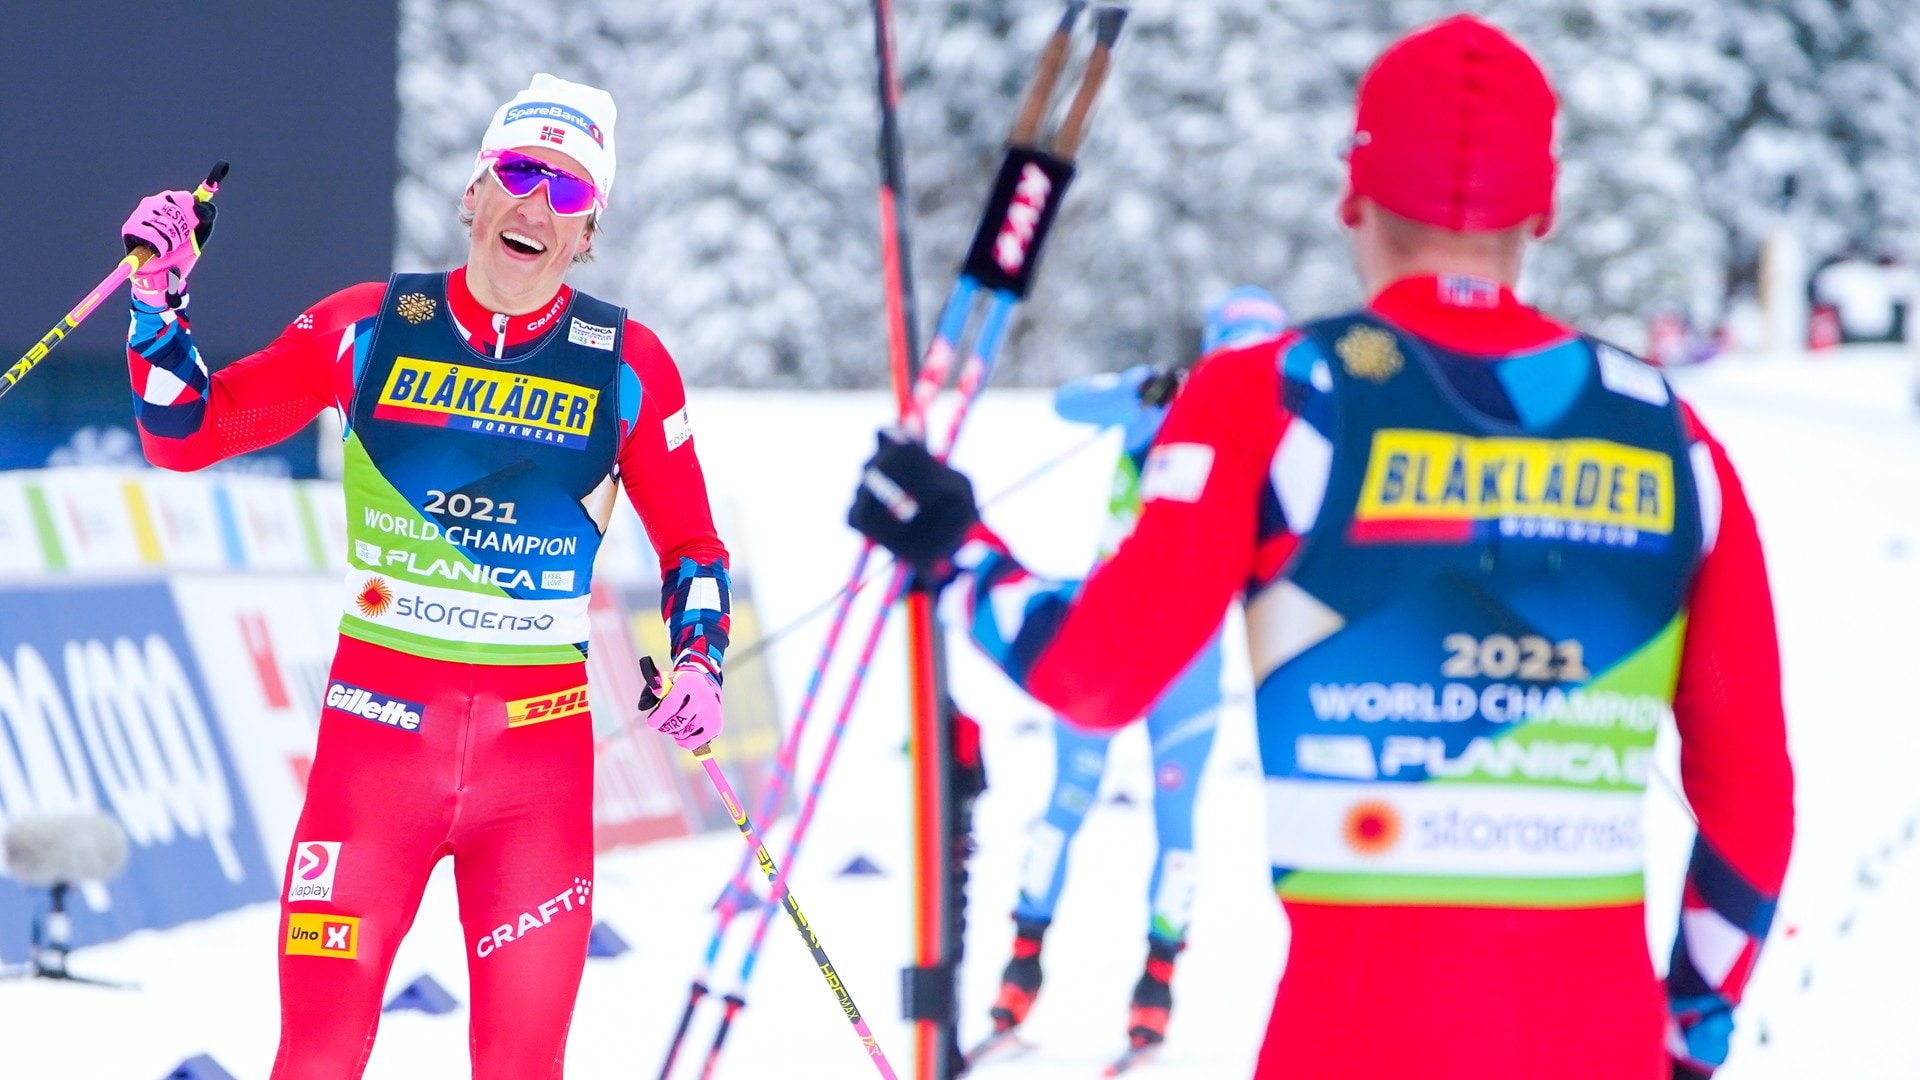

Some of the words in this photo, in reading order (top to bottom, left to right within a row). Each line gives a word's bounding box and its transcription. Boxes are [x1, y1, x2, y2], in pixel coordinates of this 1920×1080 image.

[507, 106, 588, 129] SpareBank
[161, 204, 190, 240] HESTRA
[527, 302, 561, 331] CRAFT
[573, 320, 613, 335] PLANICA
[389, 366, 590, 430] BLÅKLÄDER
[471, 419, 565, 444] WORKWEAR
[424, 489, 518, 525] 2021
[364, 506, 439, 542] WORLD
[445, 526, 577, 556] CHAMPION
[385, 550, 536, 591] PLANICA
[1441, 632, 1590, 682] 2021
[326, 683, 421, 730] Gillette
[1308, 682, 1479, 723] WORLD
[291, 884, 330, 898] viaplay
[291, 927, 319, 941] Uno
[325, 925, 349, 949] X
[476, 888, 573, 958] CRAFT
